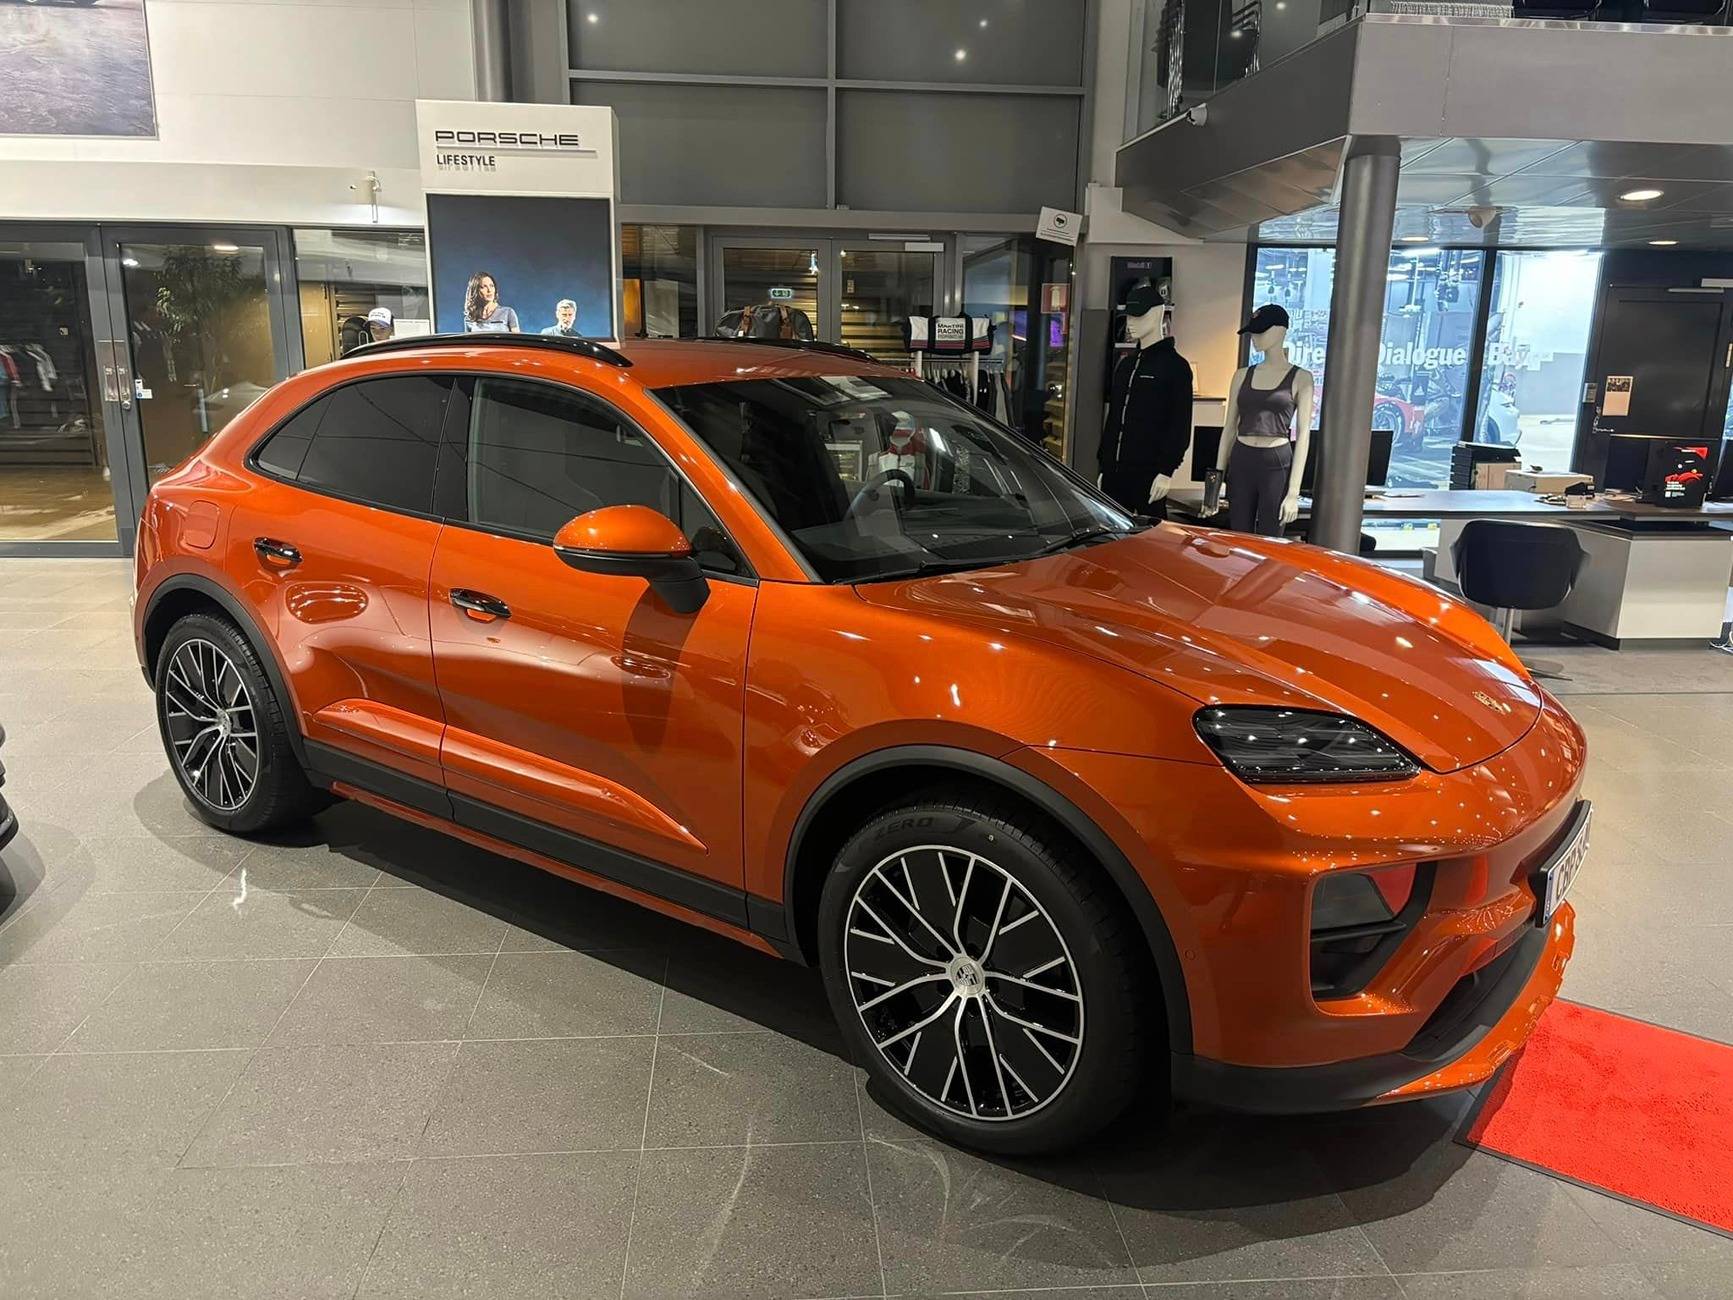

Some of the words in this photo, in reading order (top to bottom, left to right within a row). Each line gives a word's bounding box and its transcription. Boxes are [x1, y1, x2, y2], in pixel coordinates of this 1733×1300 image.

[435, 130, 579, 146] PORSCHE
[436, 154, 496, 167] LIFESTYLE
[1283, 341, 1326, 365] Dire
